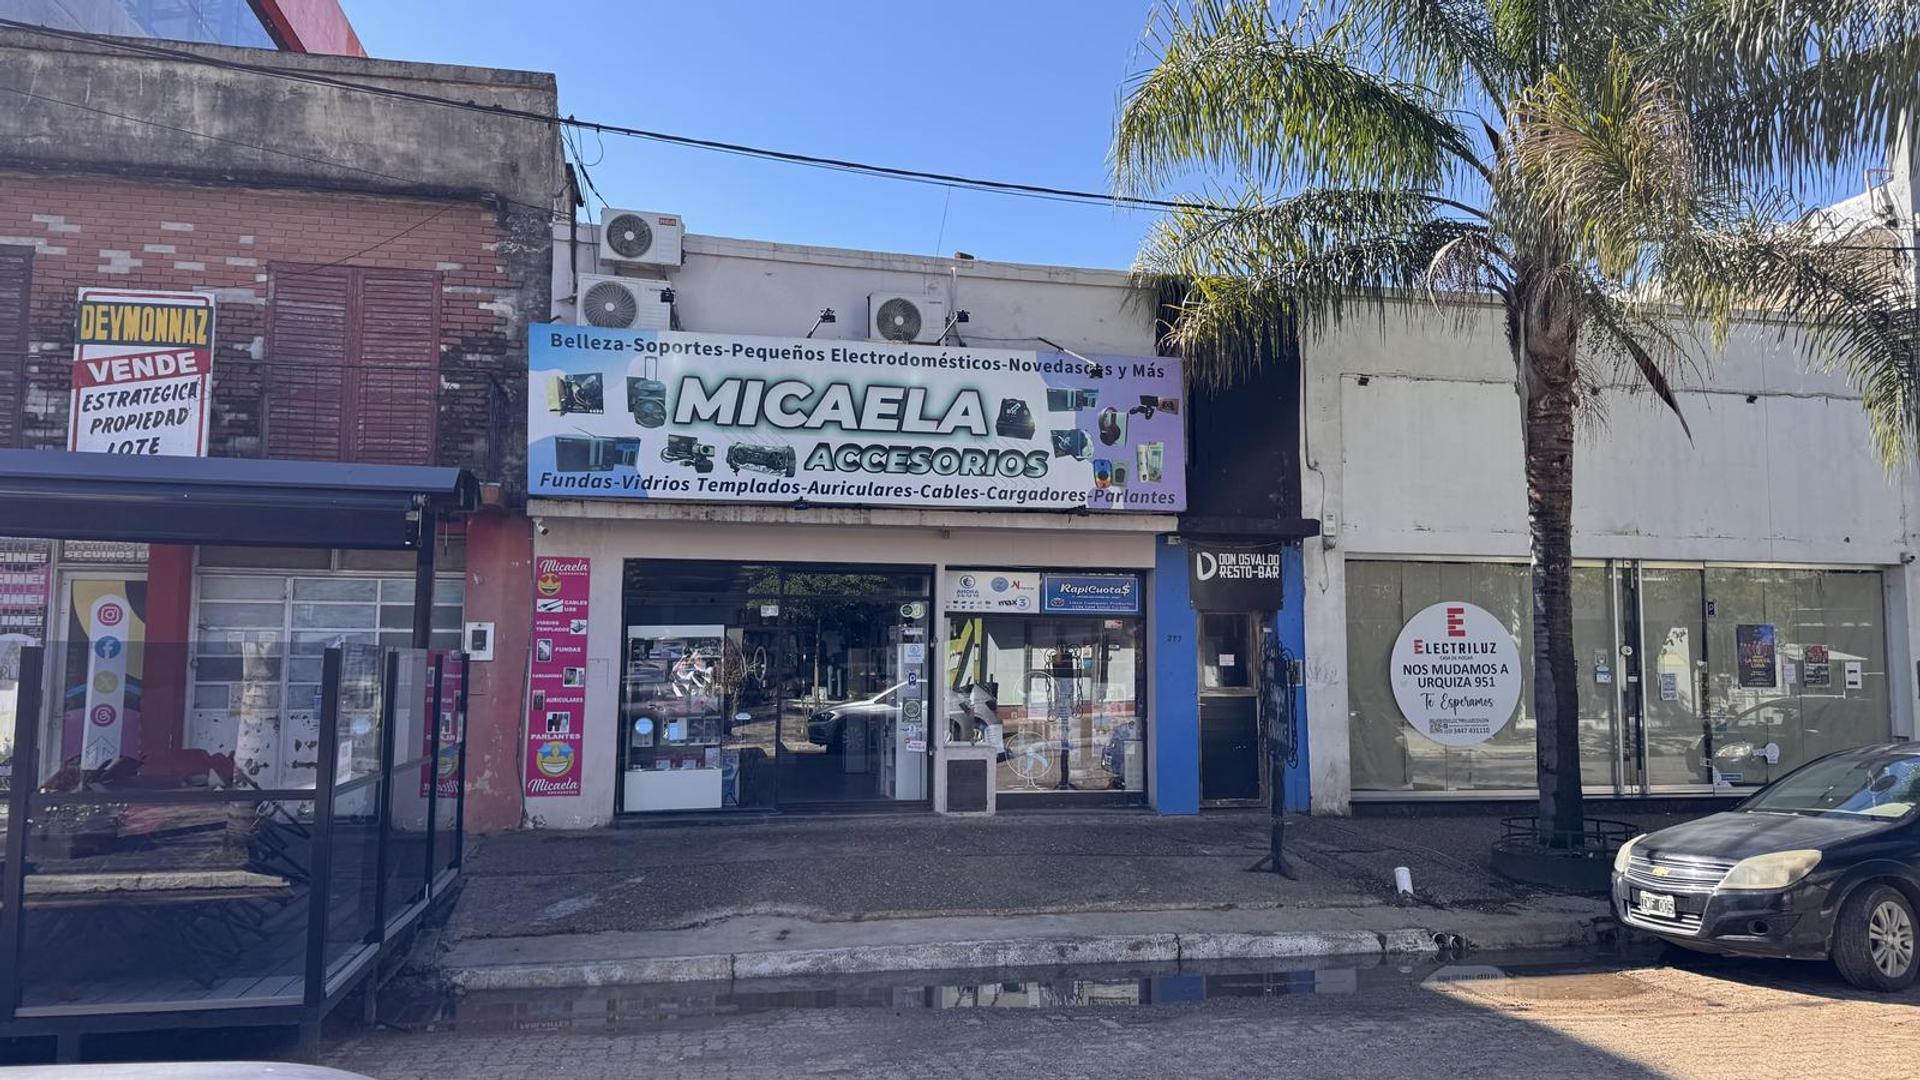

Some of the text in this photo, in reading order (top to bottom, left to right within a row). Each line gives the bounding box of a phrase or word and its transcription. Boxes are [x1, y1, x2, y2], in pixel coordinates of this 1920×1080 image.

[80, 304, 208, 345] DEYMONNAZ
[87, 351, 198, 383] VENDE
[550, 333, 826, 362] Belleza-Soportes-Pequeños
[1118, 366, 1127, 379] y
[1132, 362, 1165, 378] Más
[82, 381, 198, 413] ESTRATEGICA
[672, 376, 989, 436] MICAELA
[90, 407, 189, 435] PROPIEDAD
[803, 442, 1050, 478] ACCESORIOS
[540, 472, 1176, 504] Fundas-Vidrios Templados-Auriculares-Cables-Cargadores-Parlantes
[539, 560, 588, 573] Micaela
[1219, 553, 1280, 566] DON OSVALDO
[0, 573, 45, 584] INE!
[1219, 566, 1280, 579] RESTO-BAR
[1414, 639, 1497, 655] ELECTRILUZ
[1403, 663, 1509, 676] NOS MUDAMOS A
[1418, 676, 1496, 689] URQUIZA 951
[1420, 692, 1494, 716] Te Esperamos
[528, 777, 578, 792] Micaela
